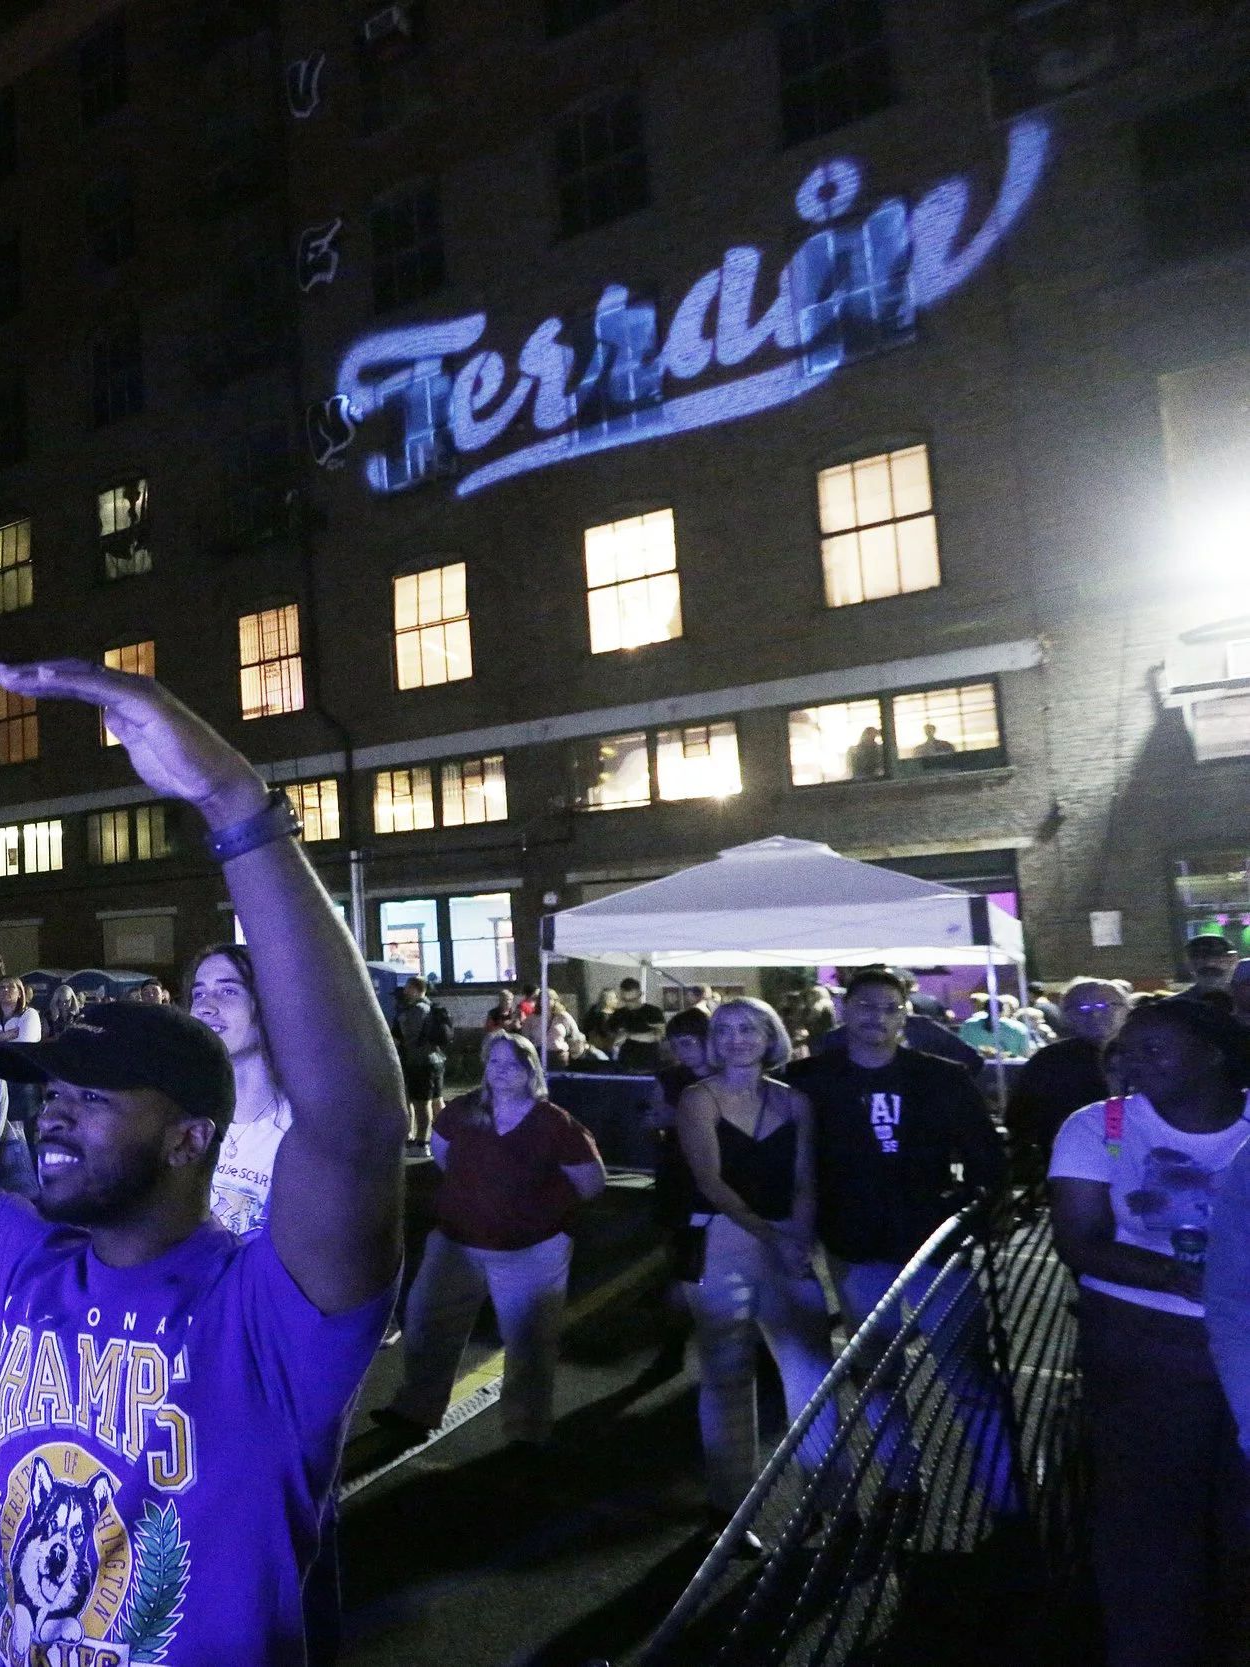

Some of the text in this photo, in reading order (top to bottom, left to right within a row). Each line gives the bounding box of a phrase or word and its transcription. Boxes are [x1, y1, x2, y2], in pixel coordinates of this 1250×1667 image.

[336, 116, 1052, 497] Terrain
[238, 1167, 269, 1187] SCAR
[63, 1449, 79, 1475] OF
[92, 1508, 127, 1624] HINGTON
